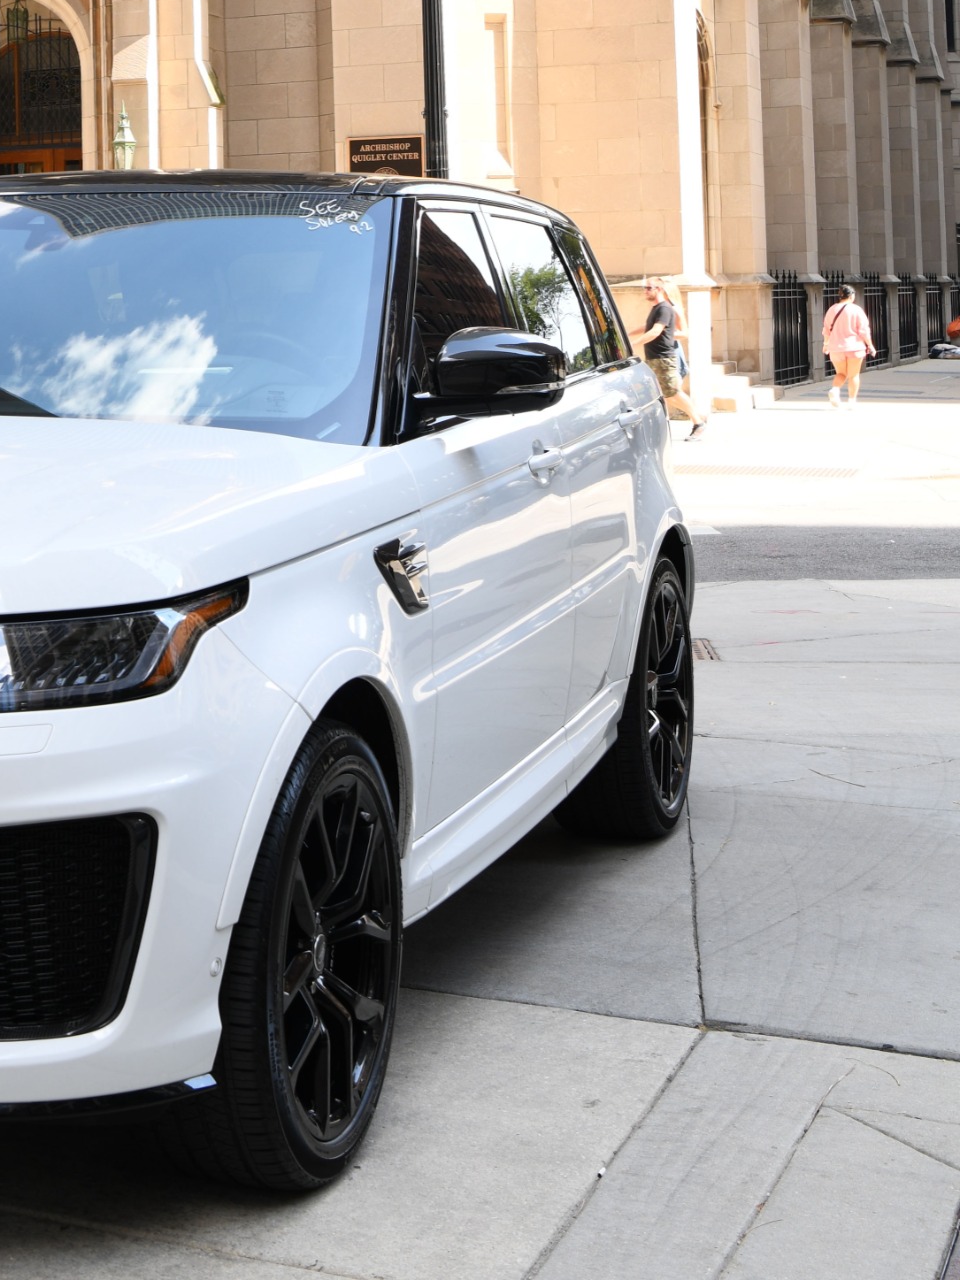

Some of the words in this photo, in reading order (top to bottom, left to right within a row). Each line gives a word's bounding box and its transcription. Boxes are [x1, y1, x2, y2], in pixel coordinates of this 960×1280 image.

[360, 143, 411, 152] ARCHBISHOP
[352, 153, 386, 163] QUIGLEY
[387, 152, 419, 160] CENTER
[299, 199, 341, 218] SEE
